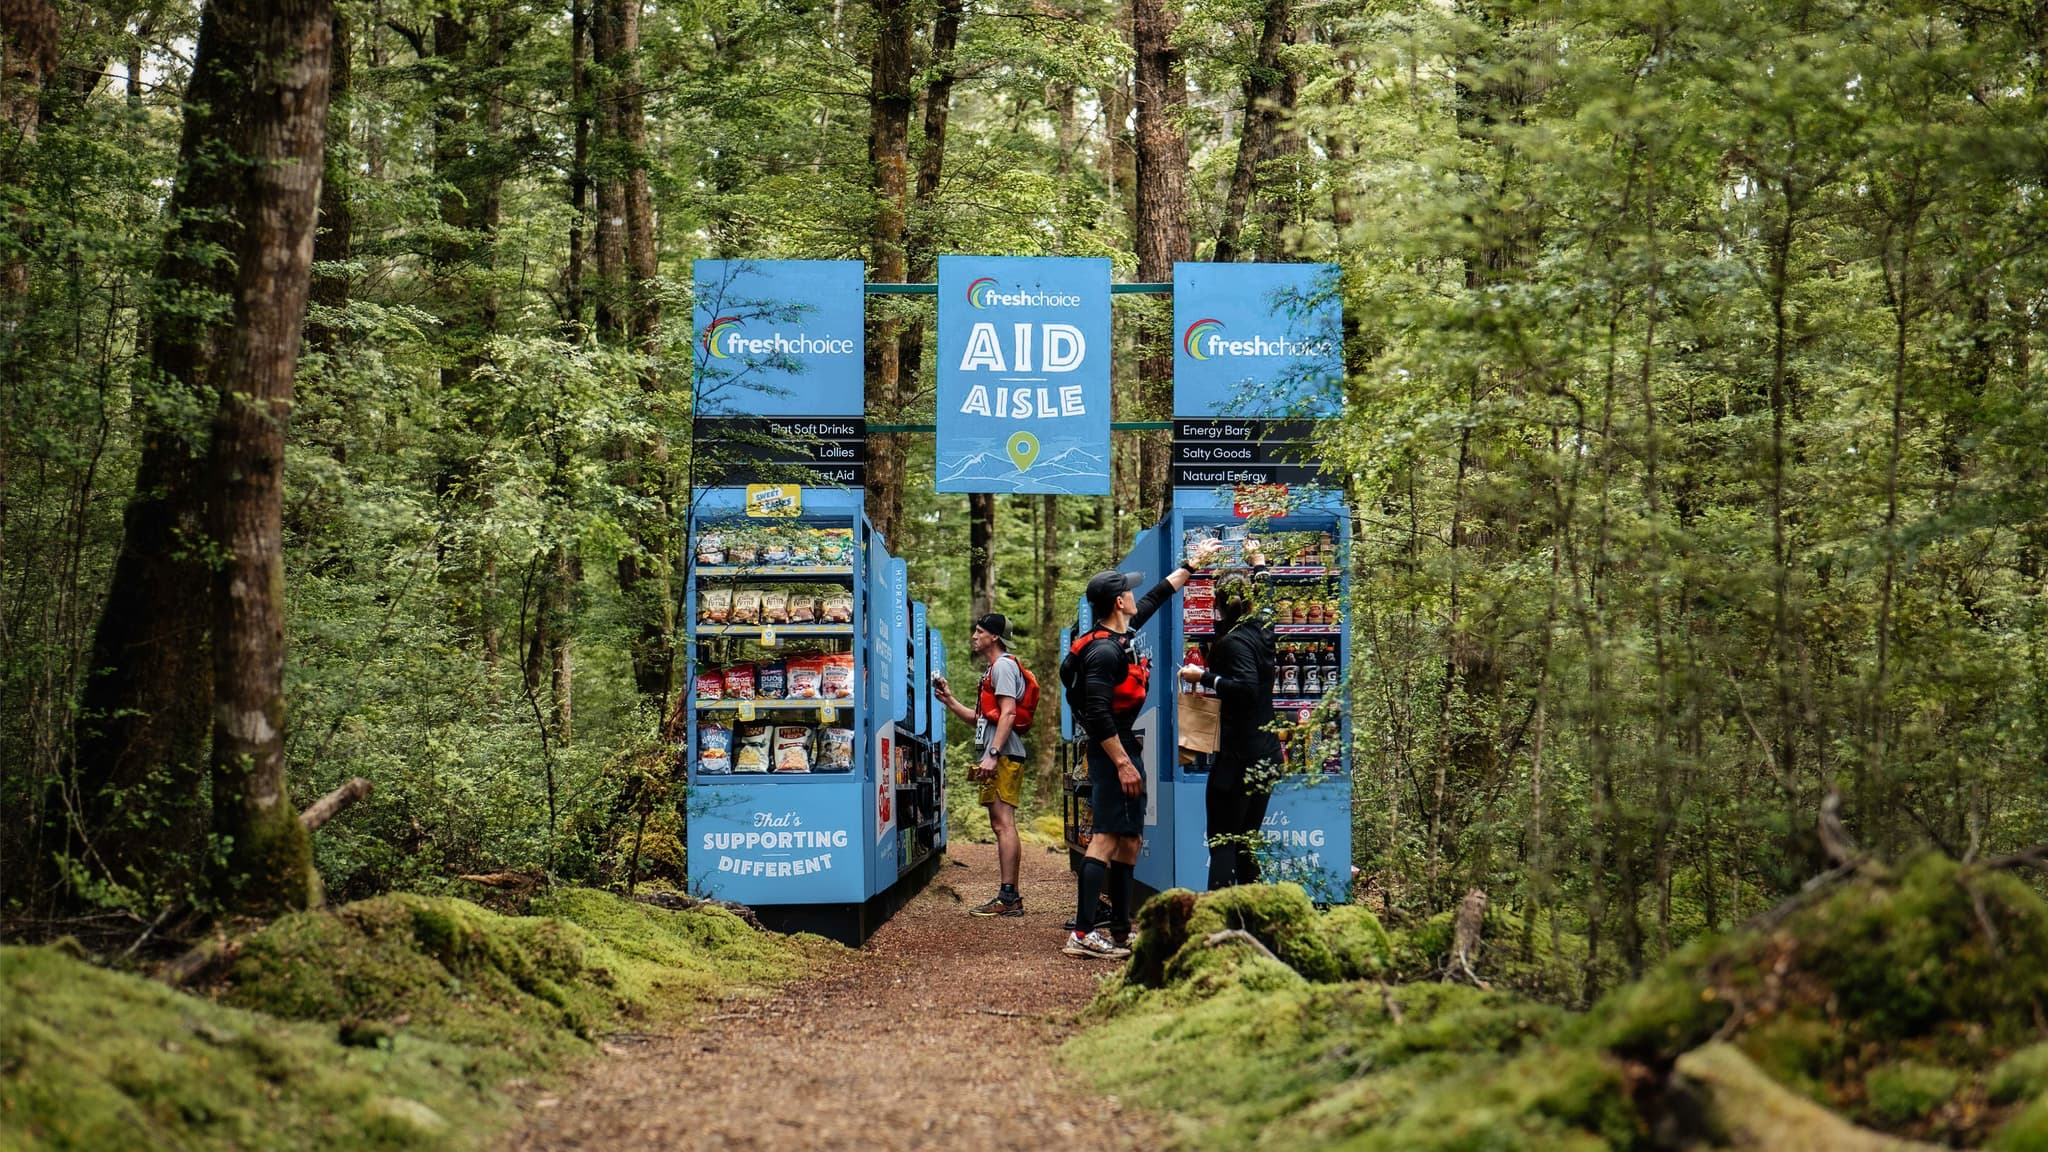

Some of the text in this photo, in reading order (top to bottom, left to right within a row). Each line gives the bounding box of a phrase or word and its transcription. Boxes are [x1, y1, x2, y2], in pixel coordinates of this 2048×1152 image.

[985, 289, 1081, 307] freshchoice
[727, 332, 854, 354] freshchoice
[960, 322, 1086, 372] AID
[960, 384, 1086, 419] AISLE
[795, 423, 818, 435] Soft
[819, 423, 855, 434] Drinks
[1183, 425, 1251, 438] Energy Bars
[820, 447, 855, 458] Lollies
[1183, 447, 1252, 461] Salty Goods
[836, 470, 855, 481] Aid
[1182, 470, 1267, 483] Natural Energy
[895, 569, 903, 628] HYDRATION
[1284, 669, 1294, 680] G
[1307, 669, 1317, 681] G
[1327, 670, 1337, 681] G
[753, 811, 802, 828] That's
[703, 829, 848, 850] SUPPORTING
[718, 852, 832, 877] DIFFERENT
